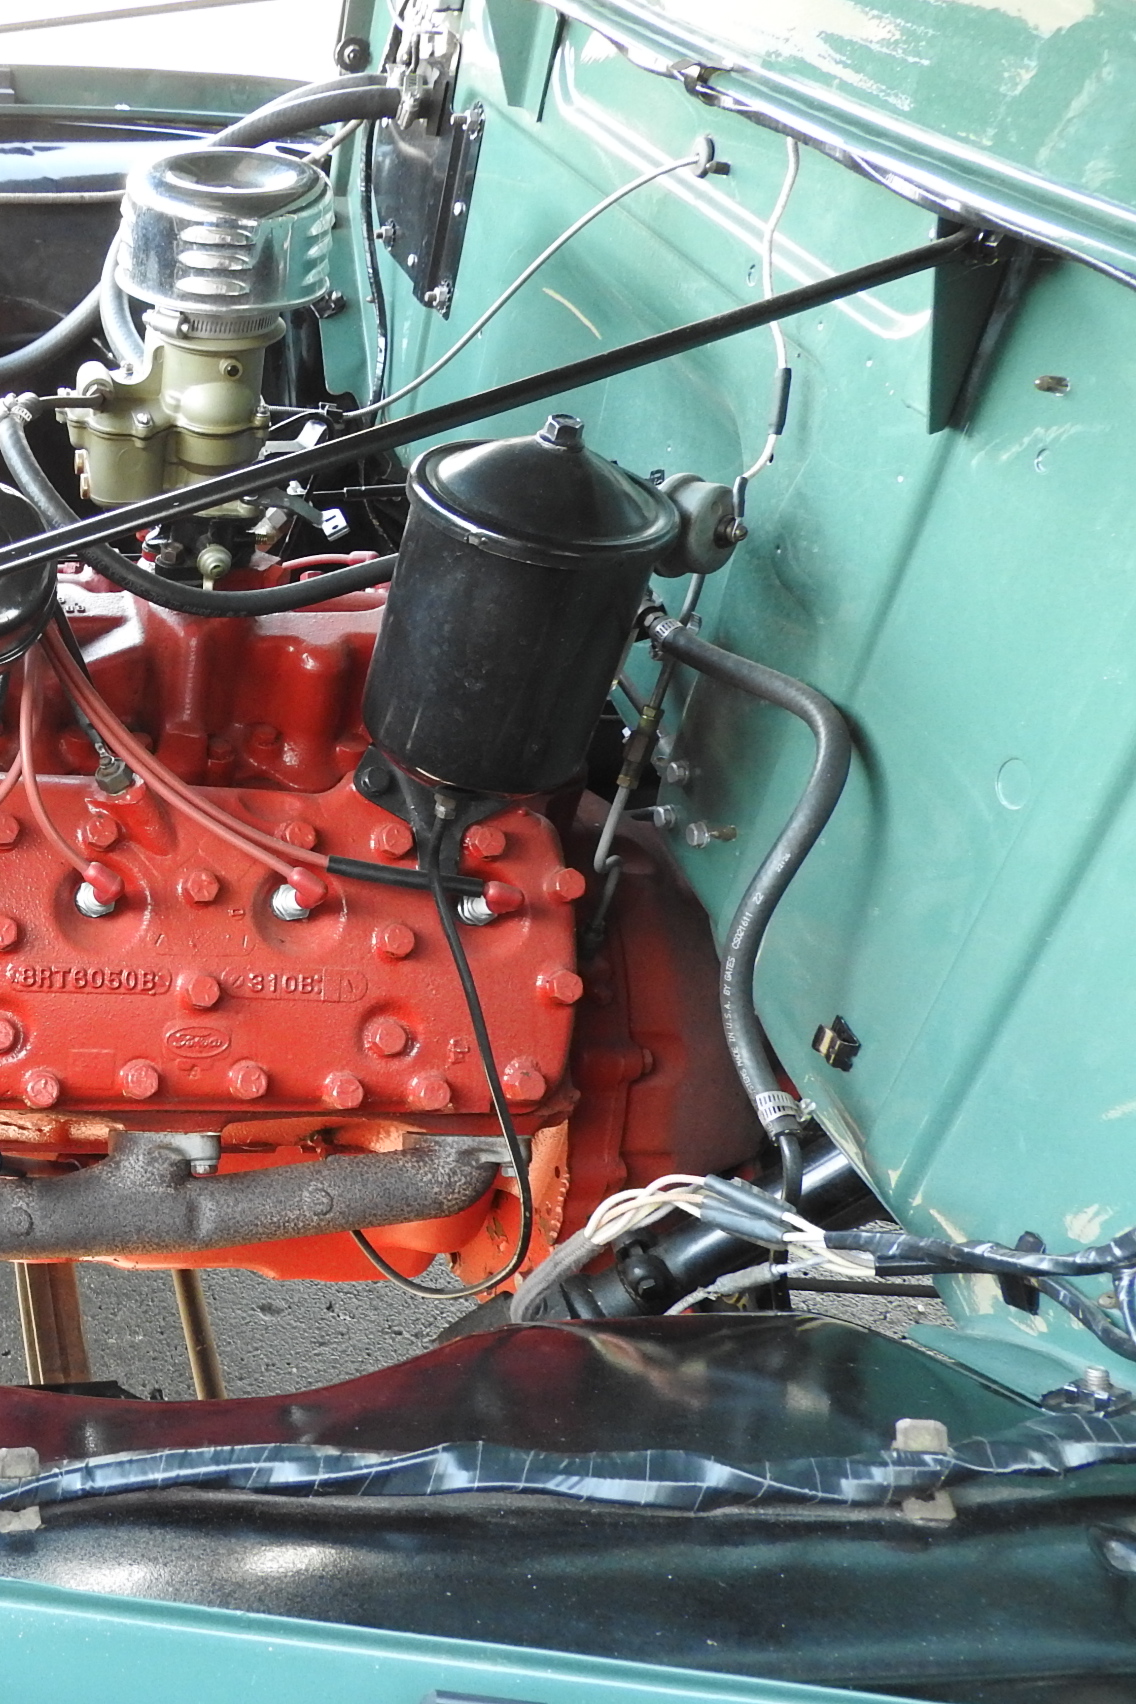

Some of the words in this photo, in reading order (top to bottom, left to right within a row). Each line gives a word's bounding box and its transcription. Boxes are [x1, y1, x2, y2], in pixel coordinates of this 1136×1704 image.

[752, 892, 764, 905] 22
[724, 956, 736, 981] GATES
[723, 984, 731, 996] BY
[728, 1032, 736, 1042] IN
[731, 1047, 743, 1066] MADE
